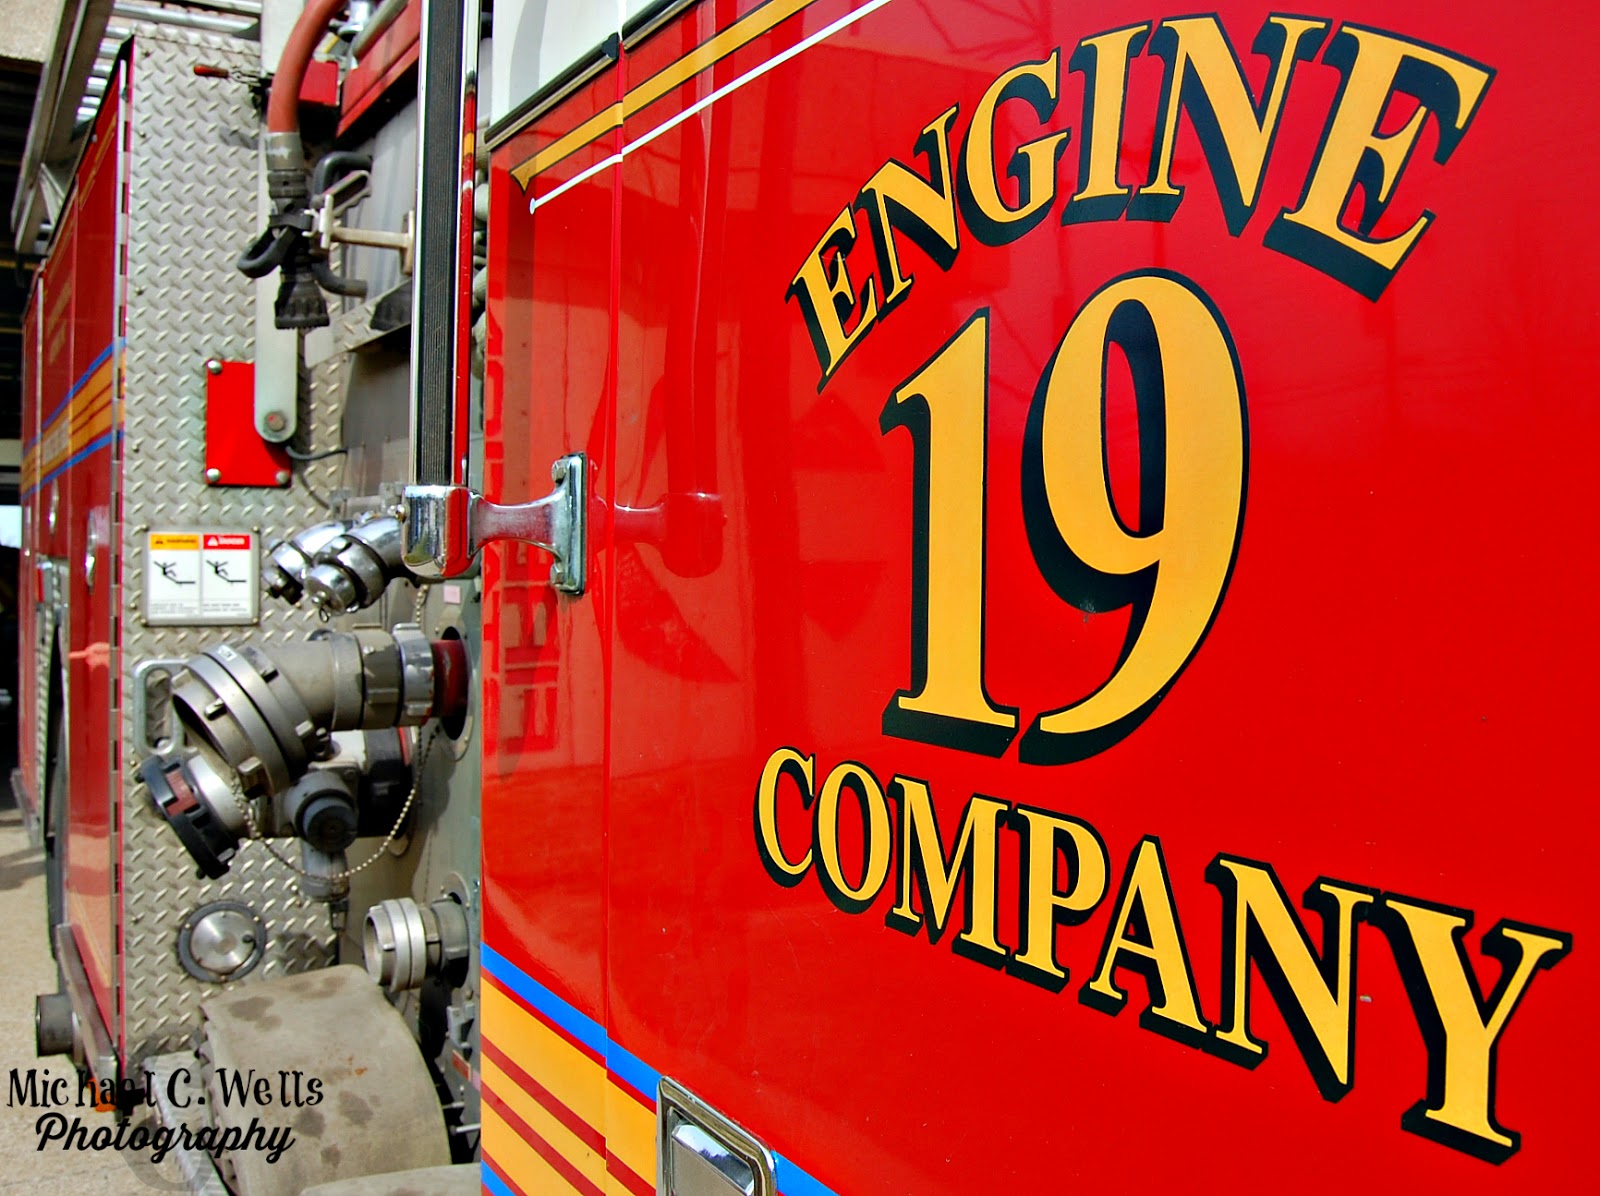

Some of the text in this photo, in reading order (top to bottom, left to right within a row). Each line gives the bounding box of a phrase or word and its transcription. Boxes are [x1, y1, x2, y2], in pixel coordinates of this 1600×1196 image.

[786, 12, 1496, 393] ENGINE
[880, 268, 1249, 766] 19
[754, 746, 1572, 1166] COMPANY
